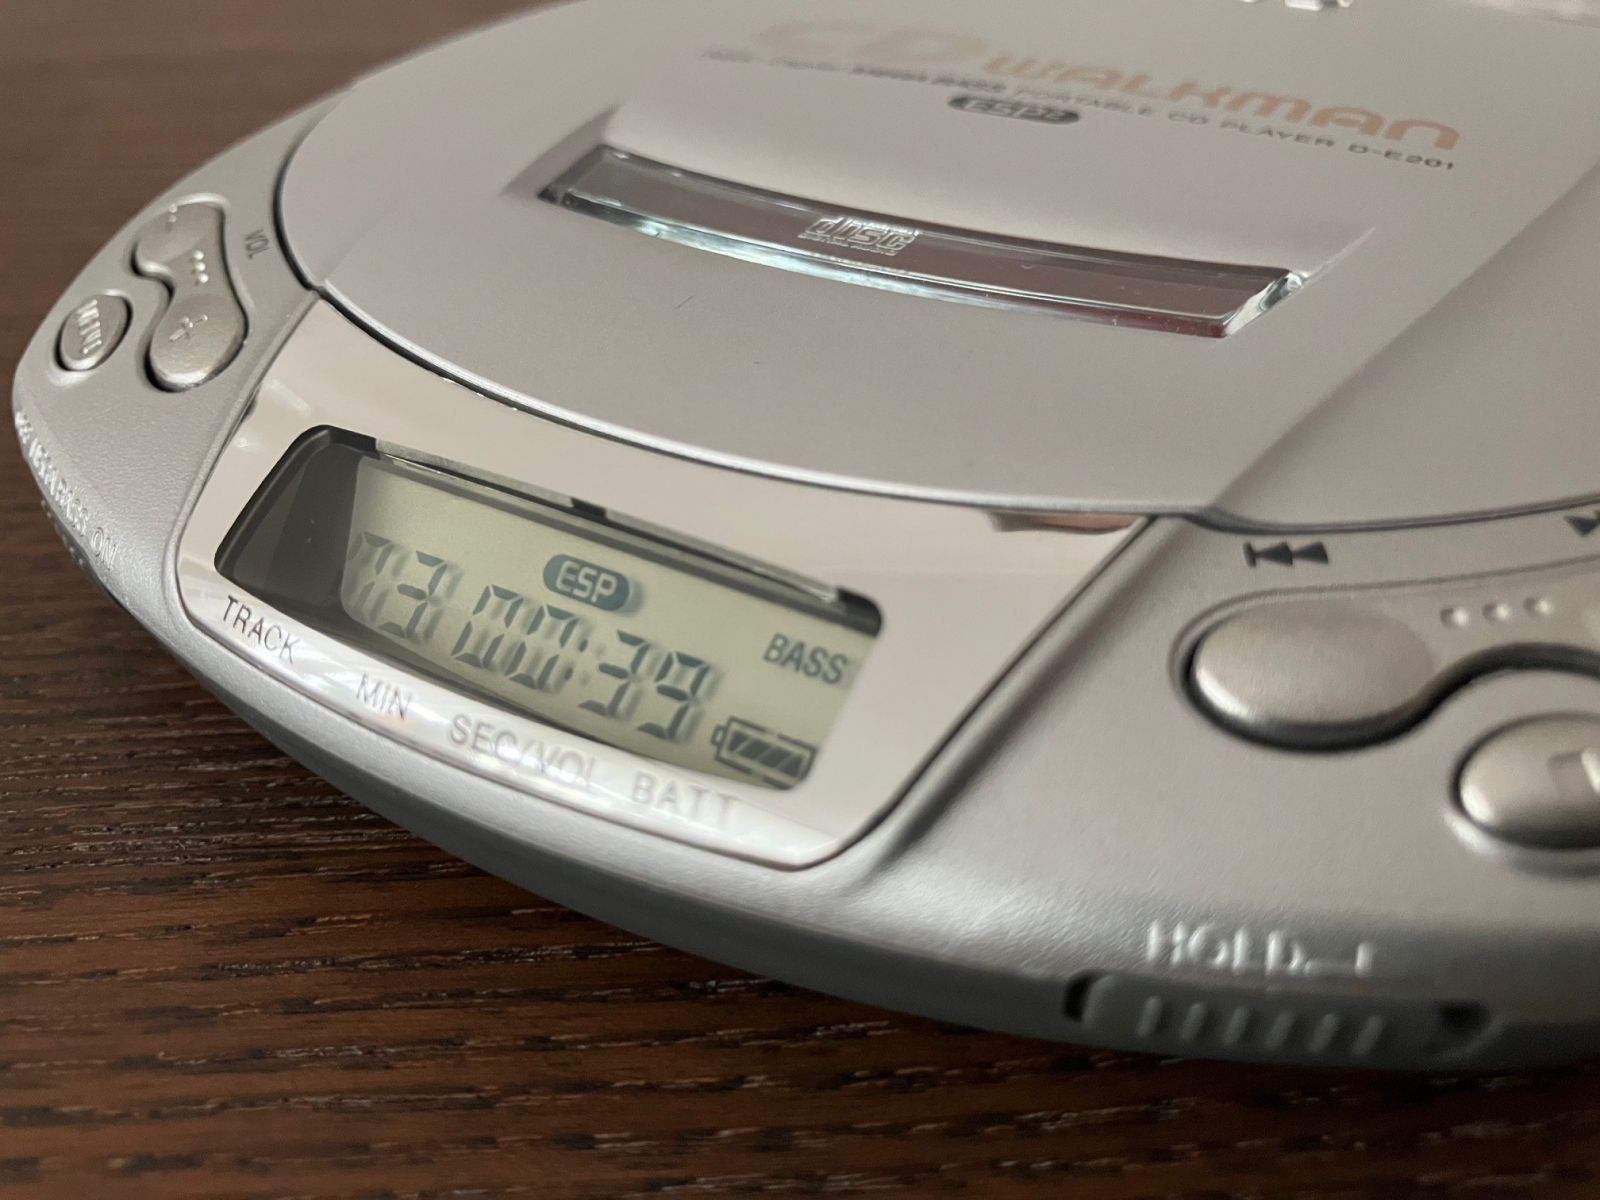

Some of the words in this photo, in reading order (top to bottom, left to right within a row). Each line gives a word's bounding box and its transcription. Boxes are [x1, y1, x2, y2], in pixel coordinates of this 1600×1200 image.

[1219, 118, 1335, 148] PLAYER
[1348, 143, 1454, 170] D-E201
[244, 228, 270, 260] VOL
[90, 526, 119, 572] ON
[555, 559, 619, 604] ESP
[763, 631, 849, 686] BASS
[221, 594, 302, 665] TRACK
[355, 672, 414, 721] MIN
[631, 770, 741, 826] BATT
